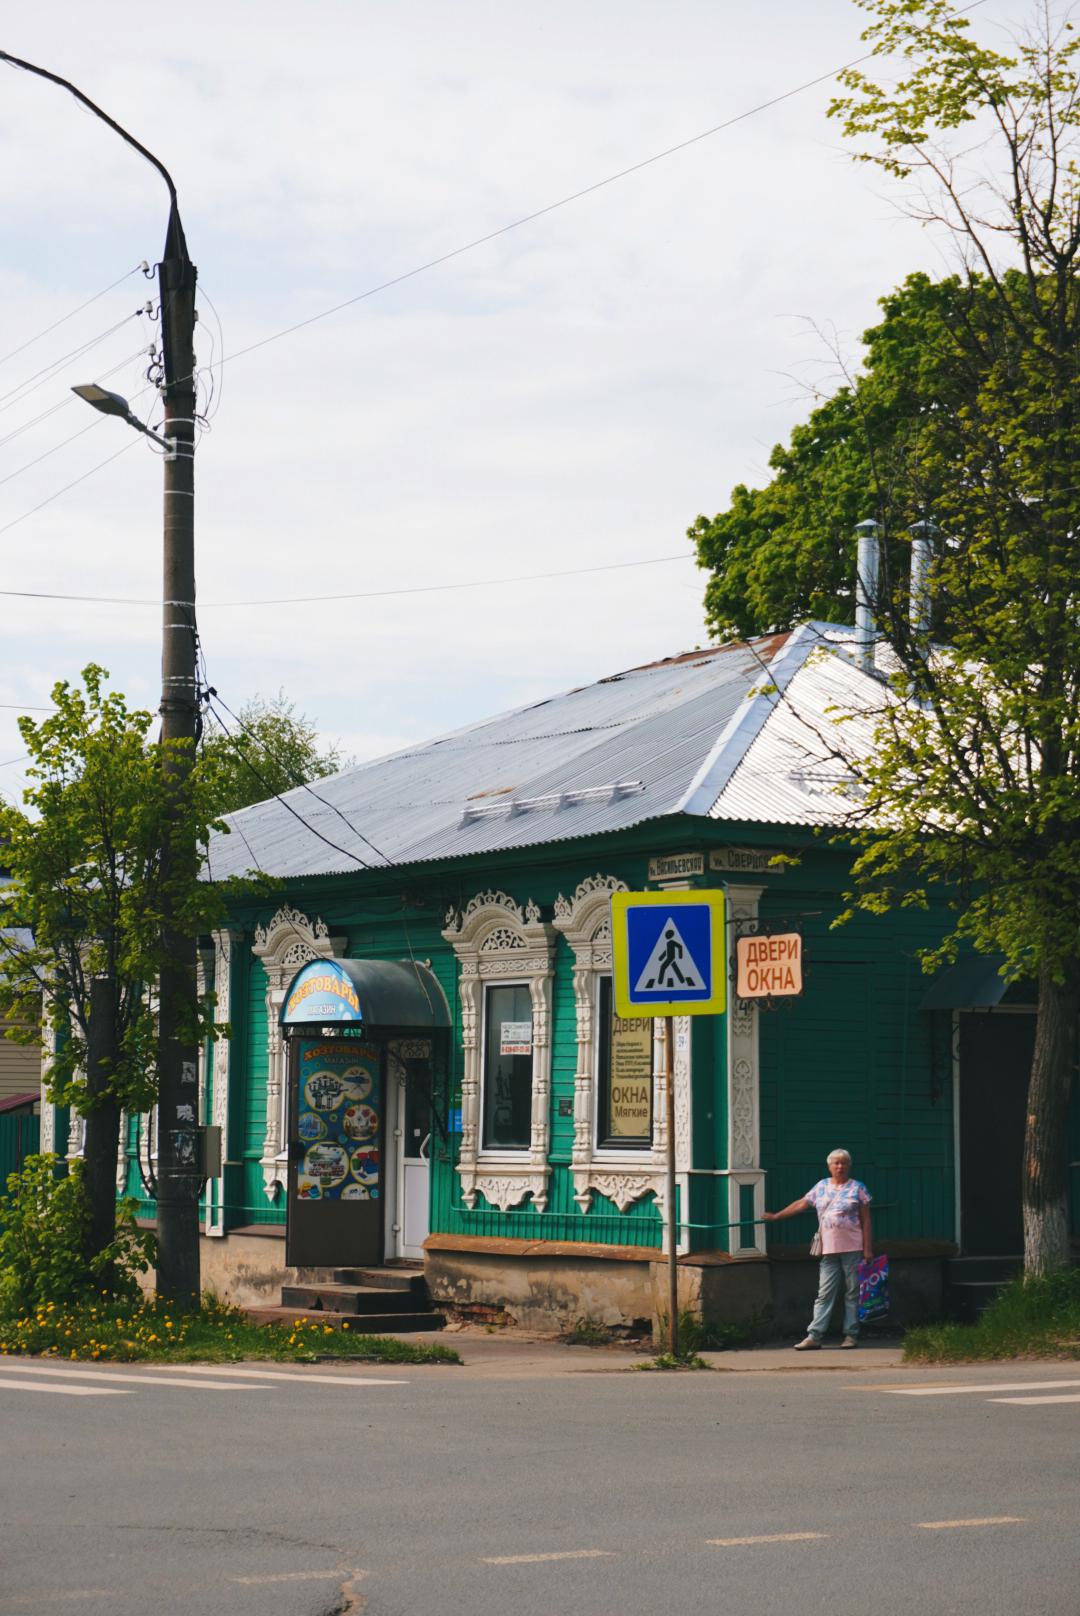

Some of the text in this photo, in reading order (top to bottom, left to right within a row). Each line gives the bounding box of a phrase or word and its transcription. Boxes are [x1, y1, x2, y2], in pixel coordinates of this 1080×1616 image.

[746, 939, 797, 968] ДВЕРИ
[747, 967, 795, 992] ОКНА
[287, 975, 360, 1016] ХОЗТОВАРЫ
[613, 1018, 650, 1036] ДВЕРИ
[612, 1086, 648, 1103] ОКНА
[614, 1106, 648, 1117] Мягкие
